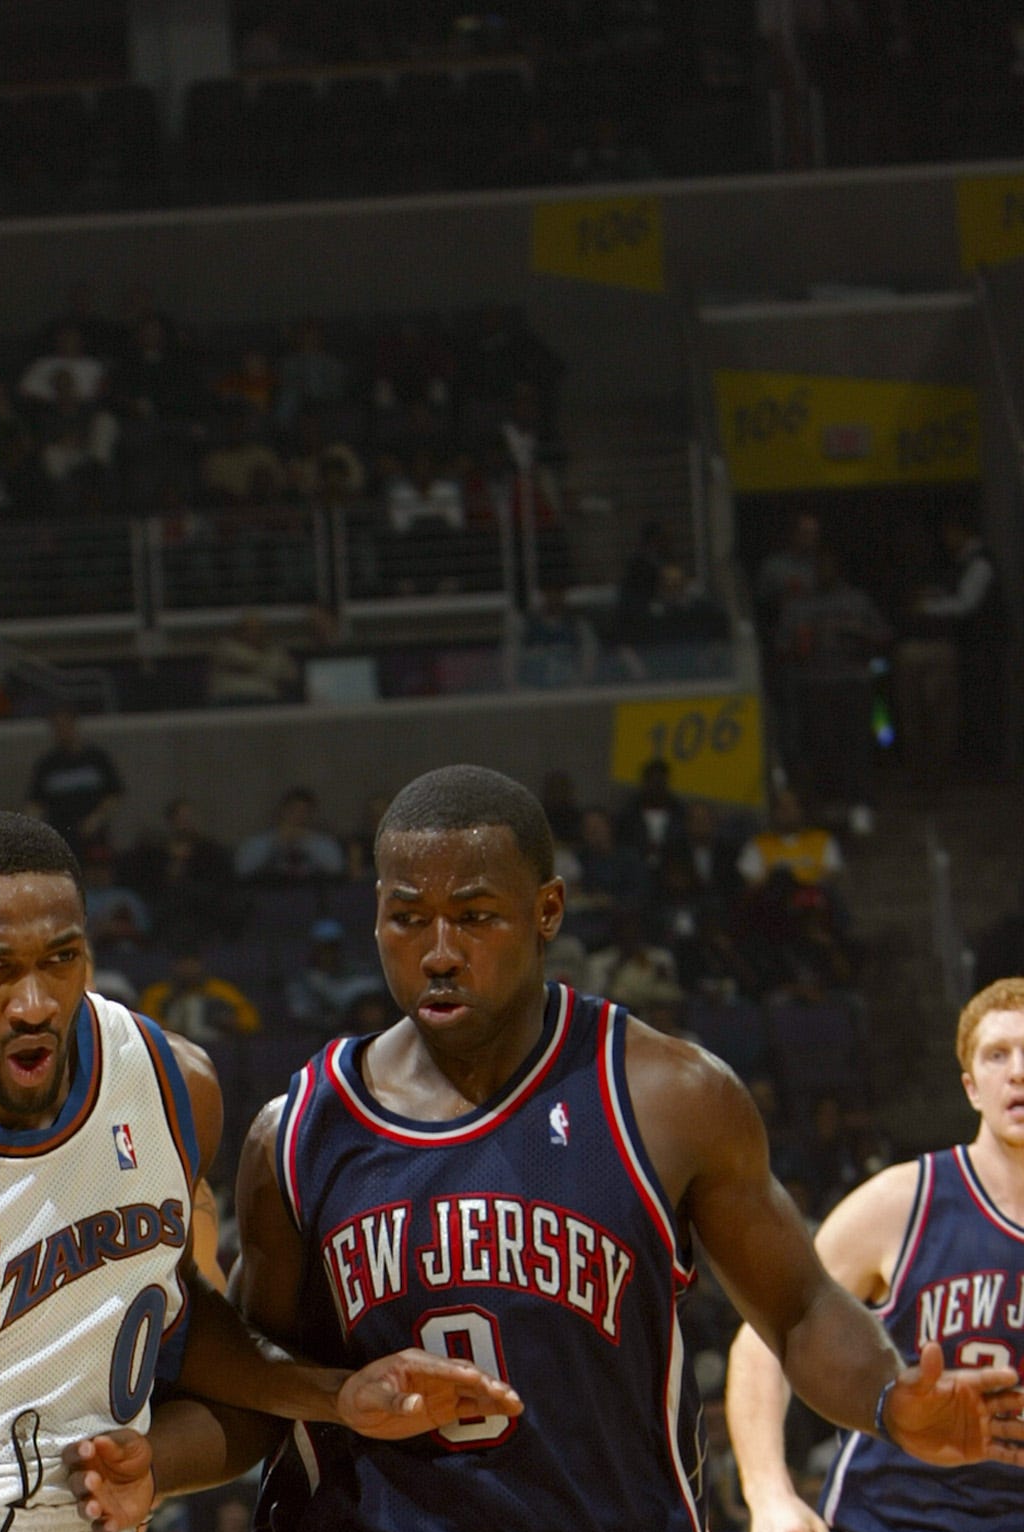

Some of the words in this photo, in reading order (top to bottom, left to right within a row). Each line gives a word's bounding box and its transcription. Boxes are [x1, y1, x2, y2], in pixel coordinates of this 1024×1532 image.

[650, 699, 746, 764] 106
[416, 1194, 635, 1346] JERSEY
[917, 1270, 1008, 1351] NEW
[109, 1283, 168, 1425] 0
